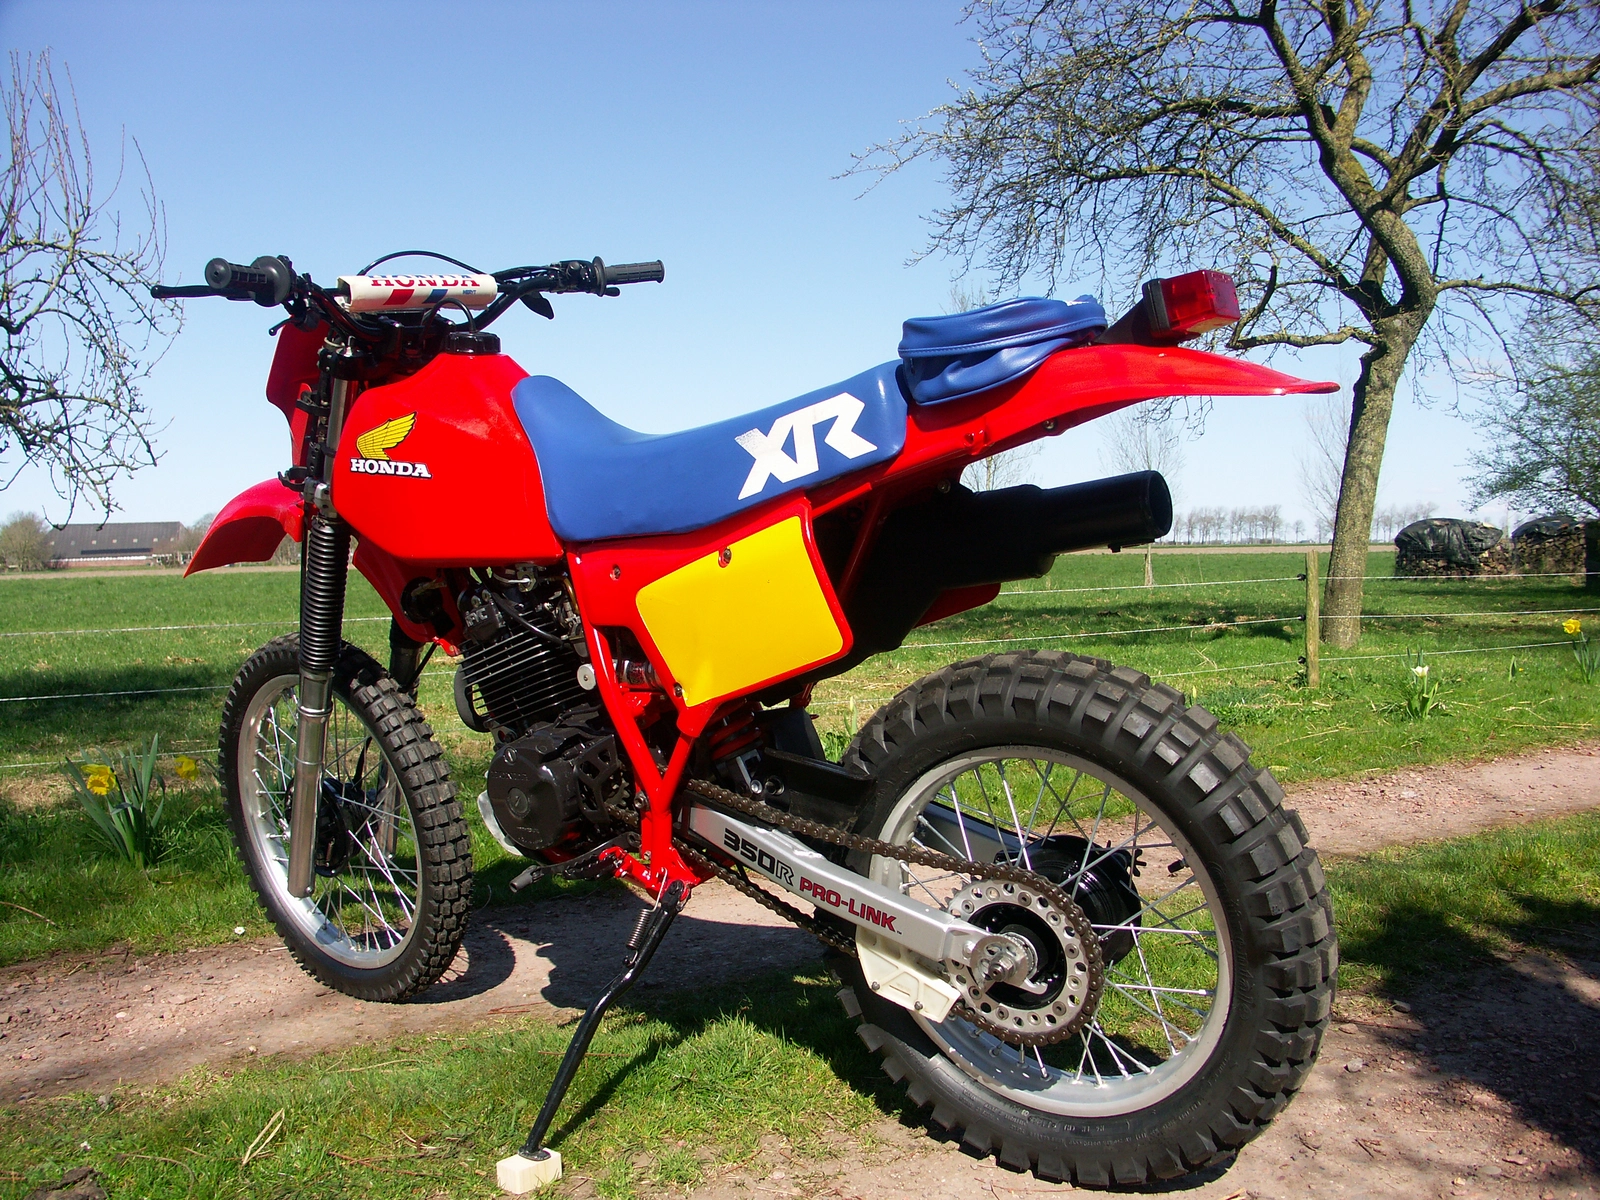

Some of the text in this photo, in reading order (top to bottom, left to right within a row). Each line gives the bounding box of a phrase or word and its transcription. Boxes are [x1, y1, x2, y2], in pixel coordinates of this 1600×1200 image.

[350, 458, 432, 478] HONDA
[724, 828, 897, 932] 350R PRO-LINK
